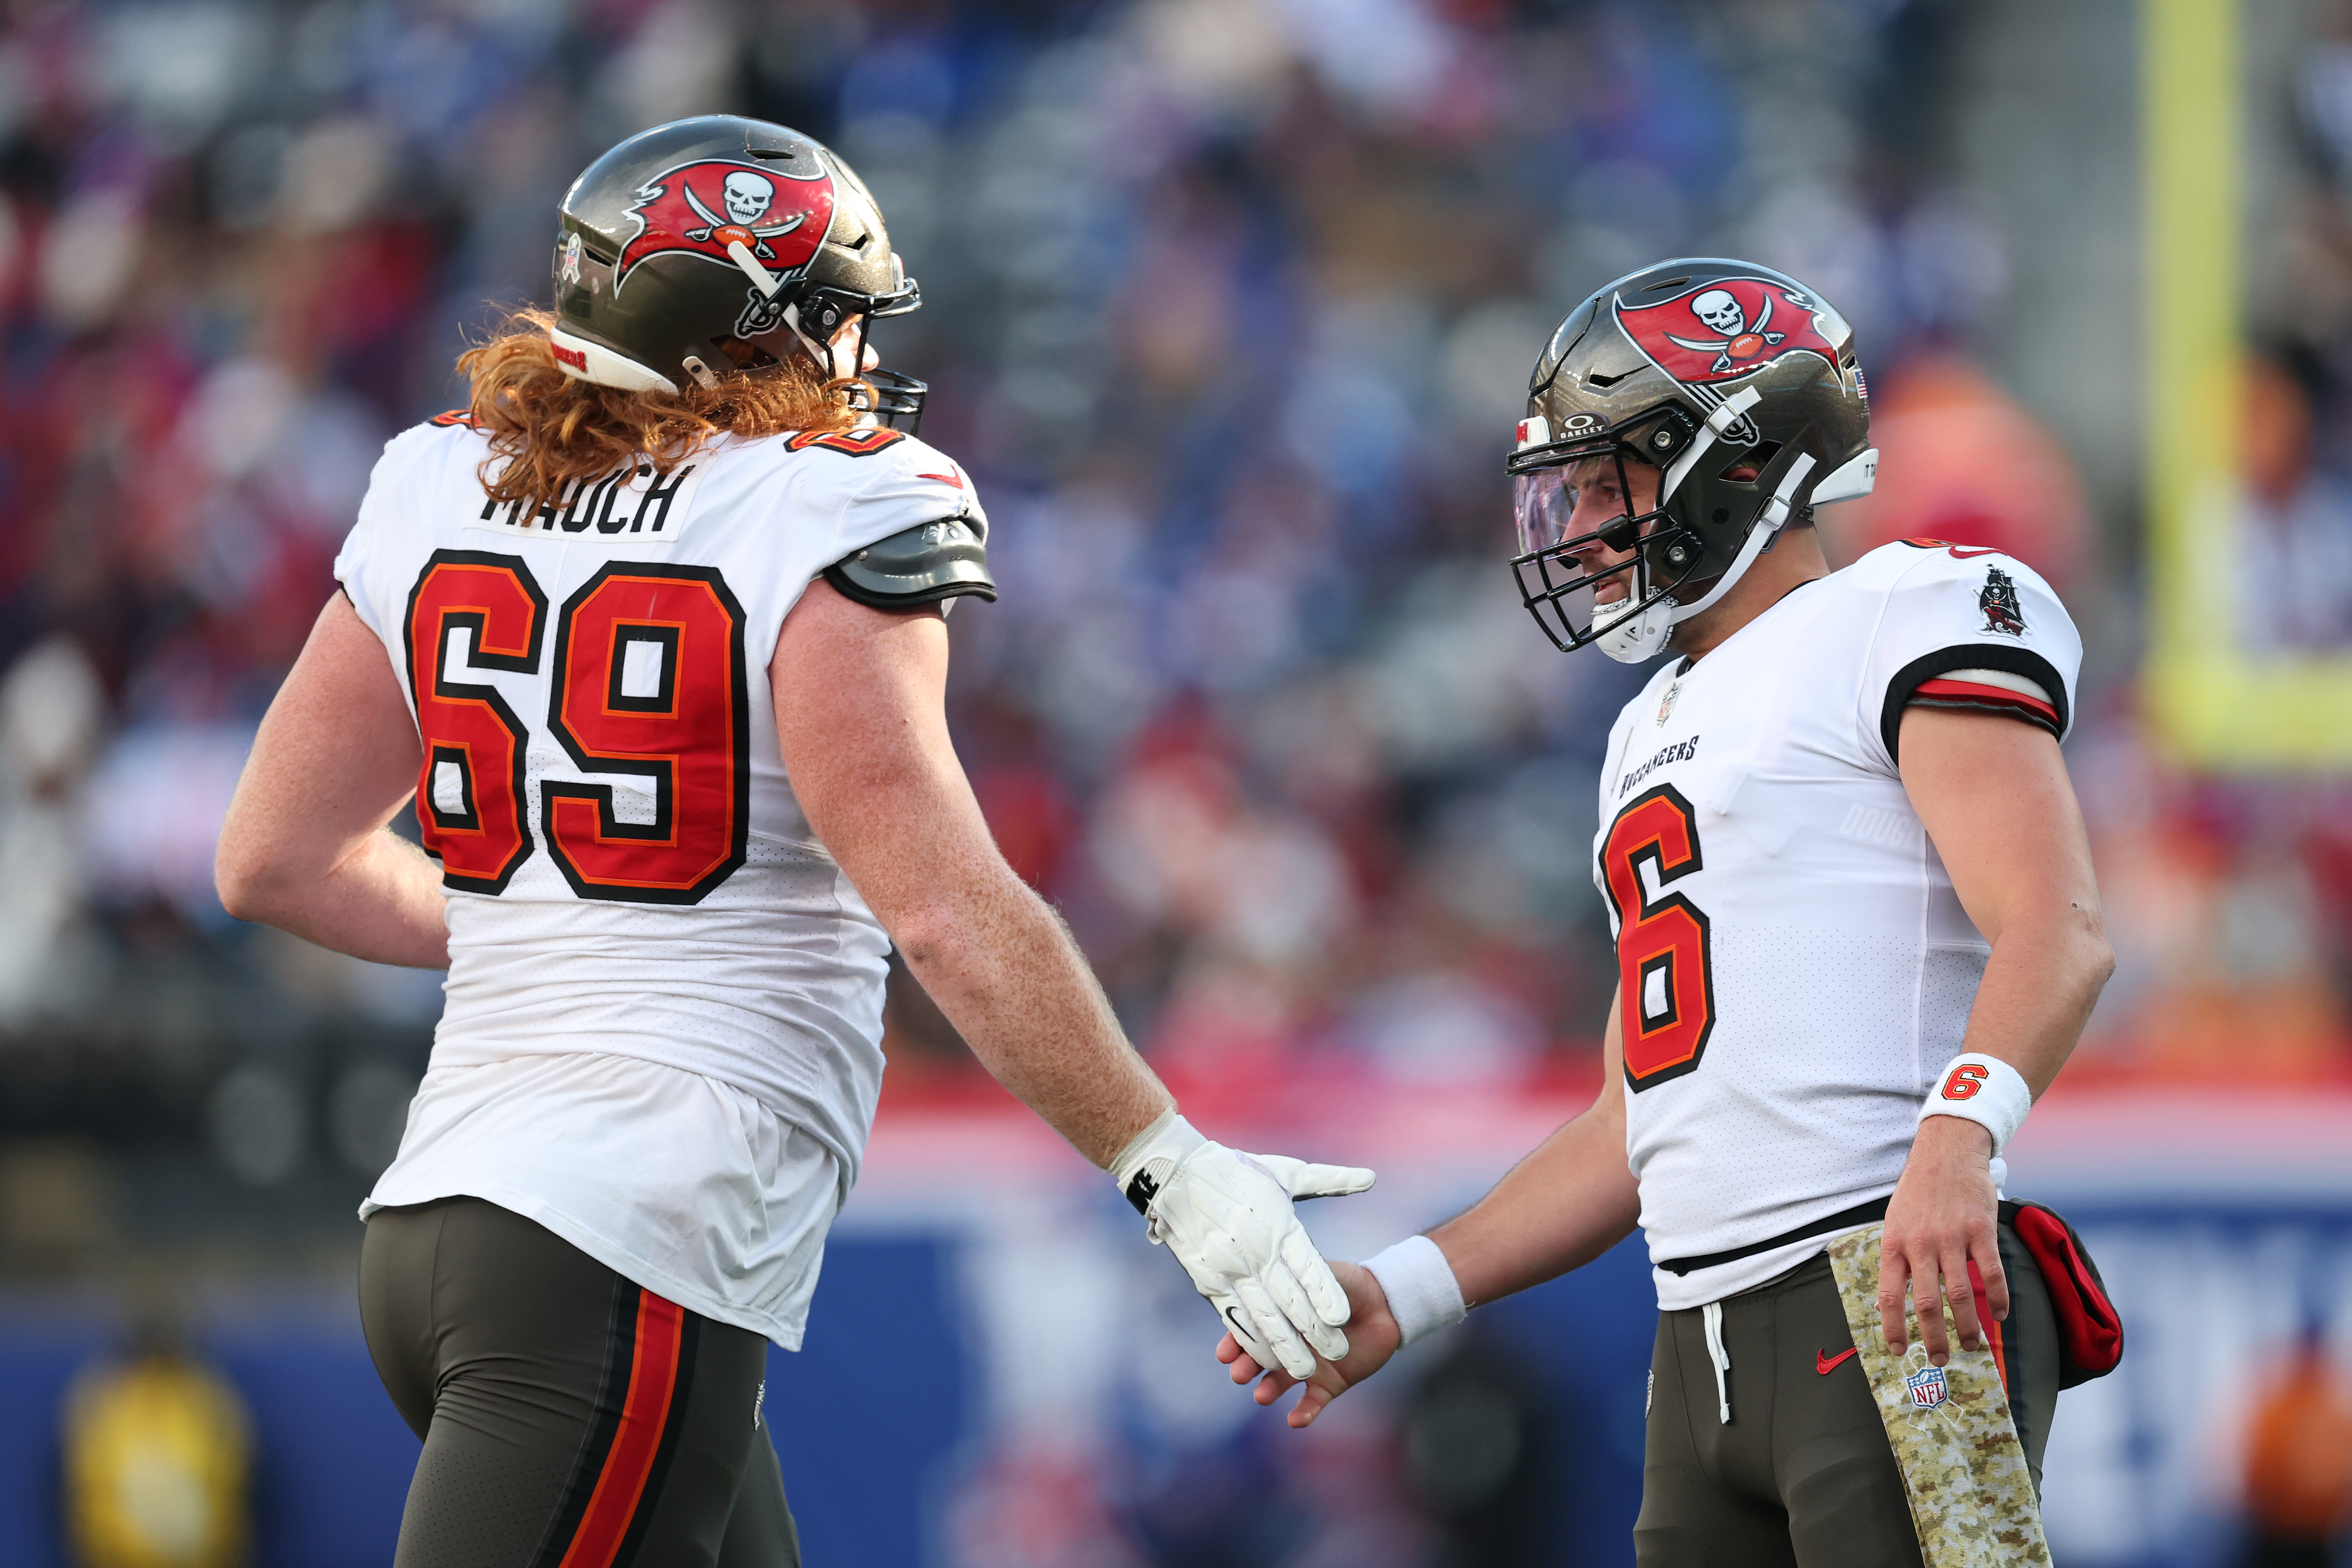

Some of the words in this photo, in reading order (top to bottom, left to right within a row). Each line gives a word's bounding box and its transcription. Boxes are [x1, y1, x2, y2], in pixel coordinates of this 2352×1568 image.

[1560, 425, 1605, 439] OAKLEY
[403, 548, 750, 906] 69
[1619, 735, 1700, 800] BUCCANEERS
[1598, 782, 1716, 1094] 6
[1941, 1064, 1989, 1100] 6
[1913, 1383, 1945, 1404] NFL
